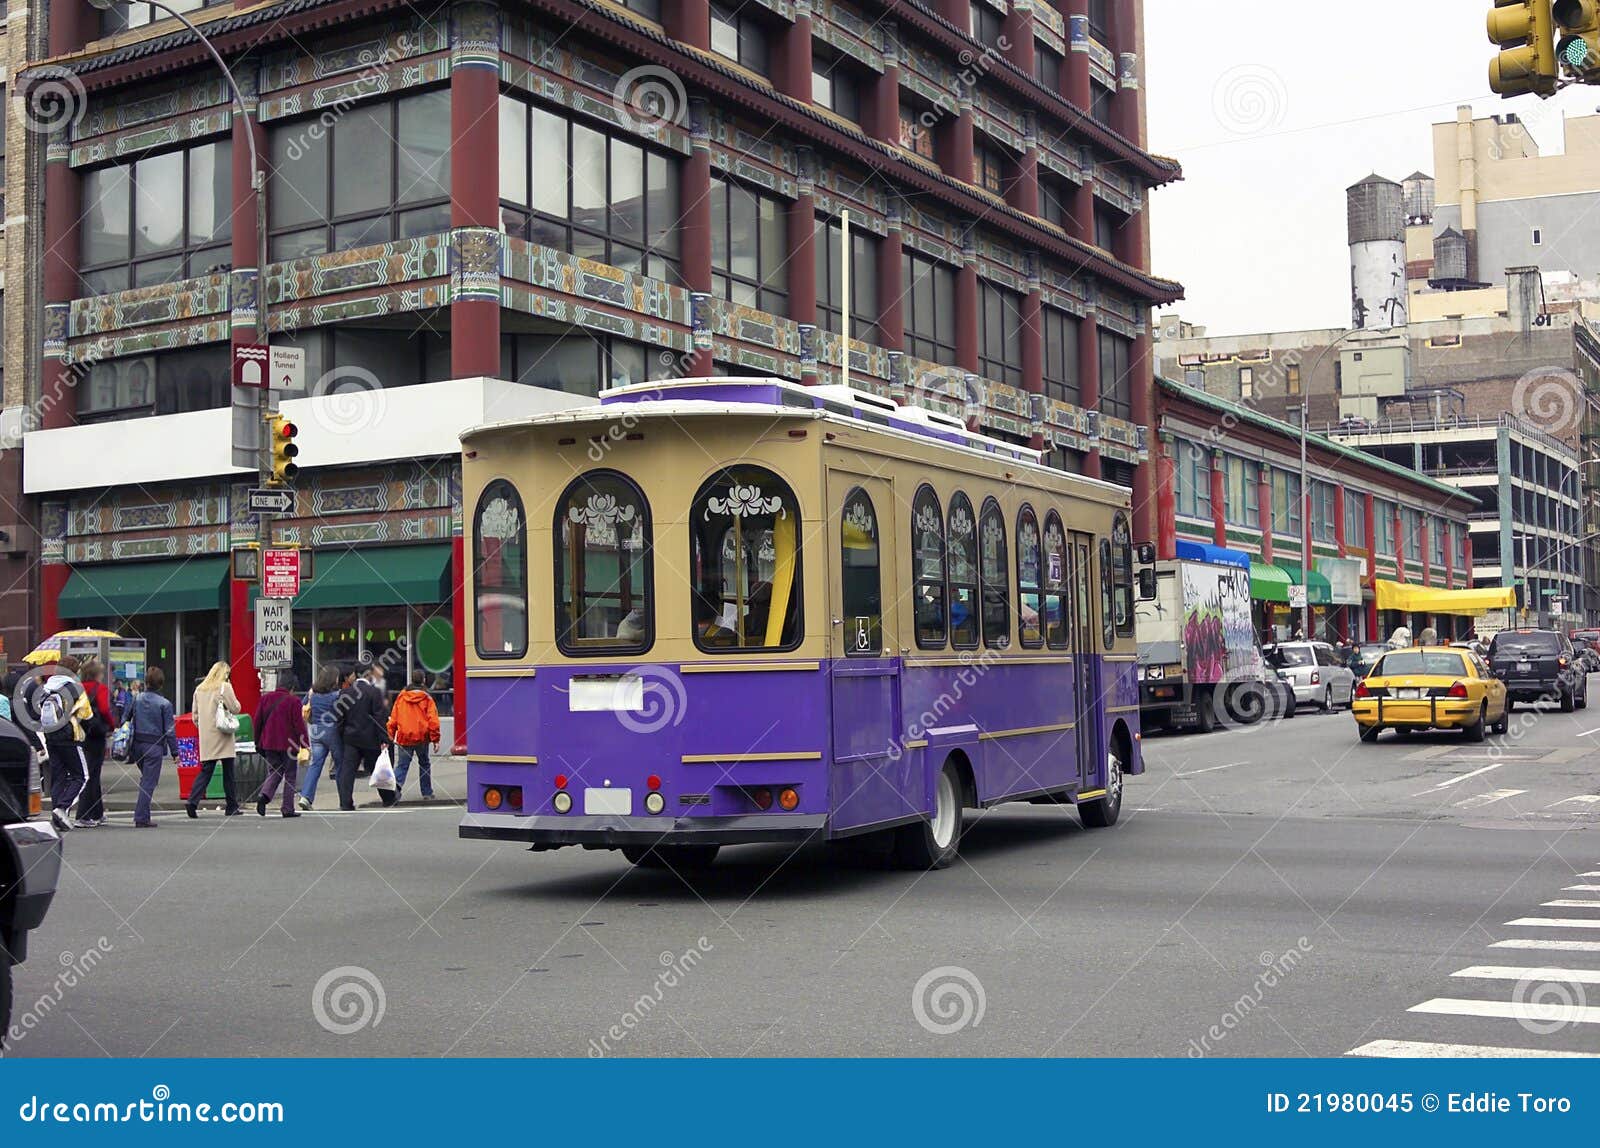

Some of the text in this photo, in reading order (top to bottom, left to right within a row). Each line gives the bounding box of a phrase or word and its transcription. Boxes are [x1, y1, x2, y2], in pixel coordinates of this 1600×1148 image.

[273, 351, 300, 361] Holland
[274, 360, 296, 369] Tunnel
[255, 496, 288, 506] ONE WAY
[262, 605, 284, 617] WAIT
[264, 620, 283, 632] FOR
[261, 634, 287, 647] WALK
[259, 650, 287, 662] SIGNAL
